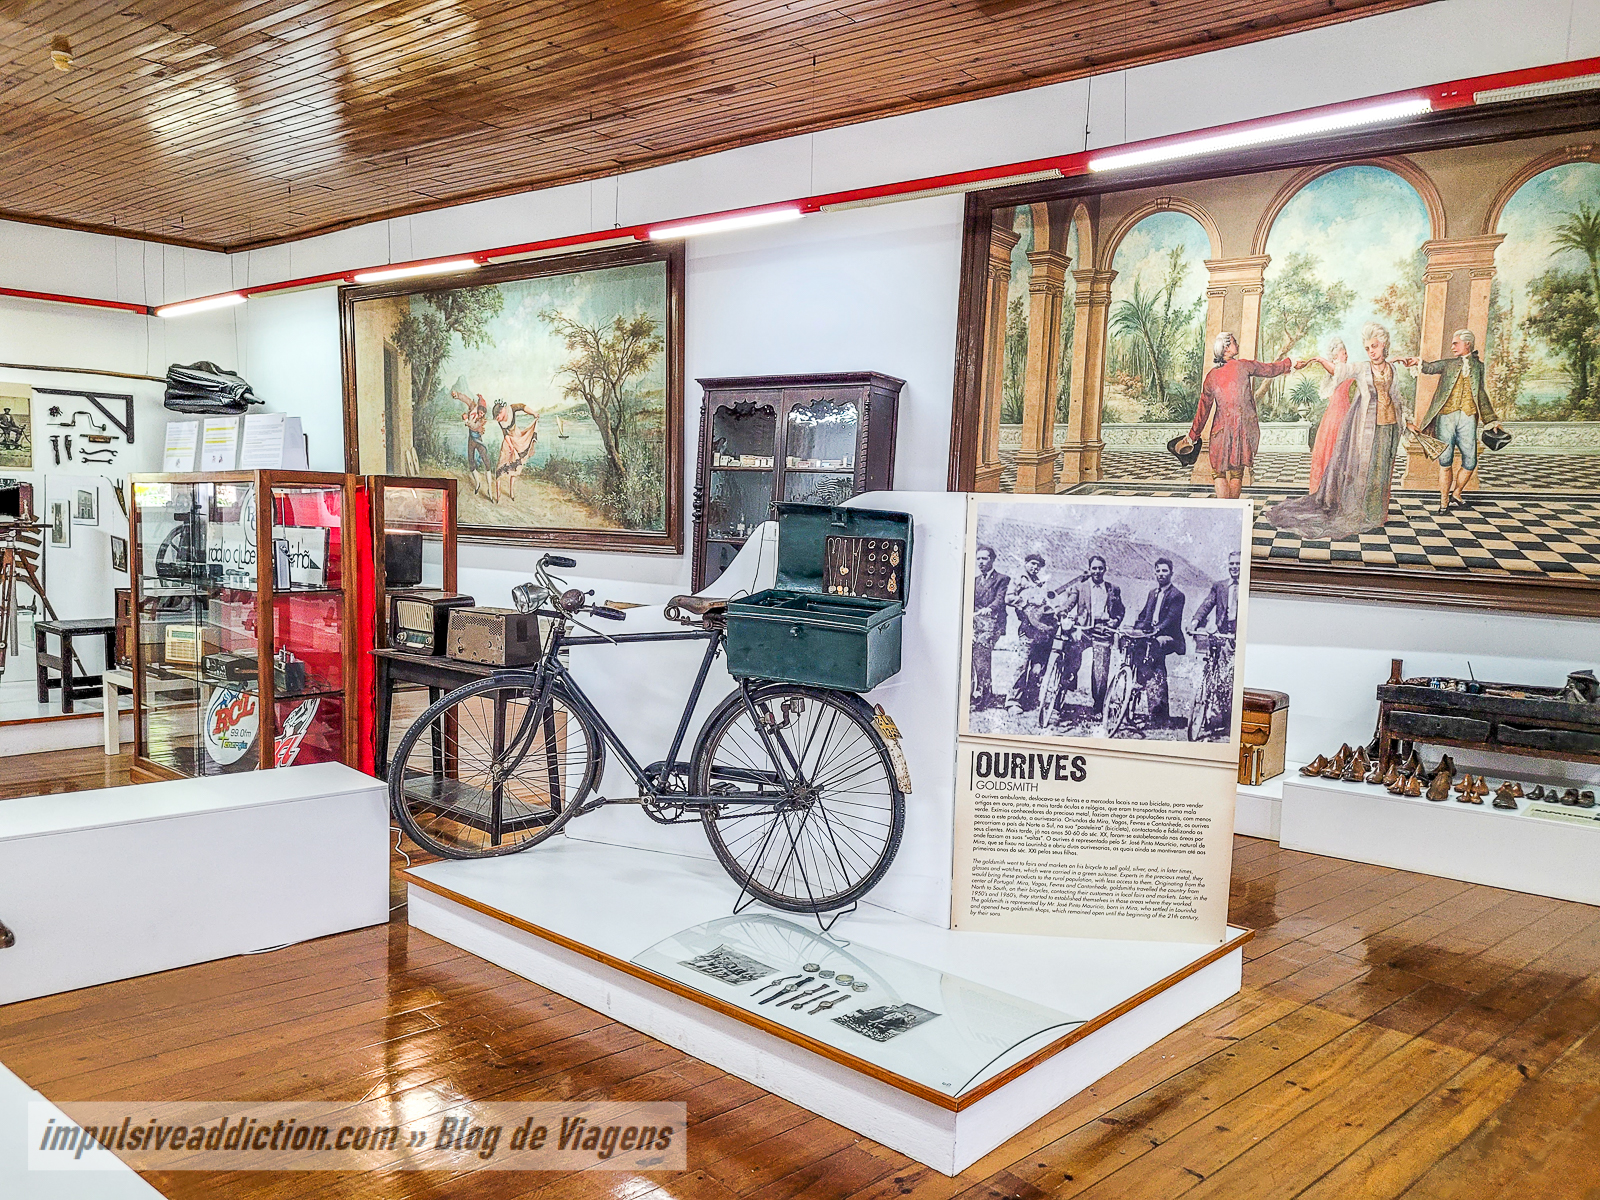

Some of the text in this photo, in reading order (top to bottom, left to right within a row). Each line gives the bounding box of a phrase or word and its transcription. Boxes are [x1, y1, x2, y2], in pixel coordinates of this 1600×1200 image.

[213, 691, 255, 735] RCL
[976, 751, 1087, 782] OURIVES
[976, 780, 1039, 792] GOLDSMITH
